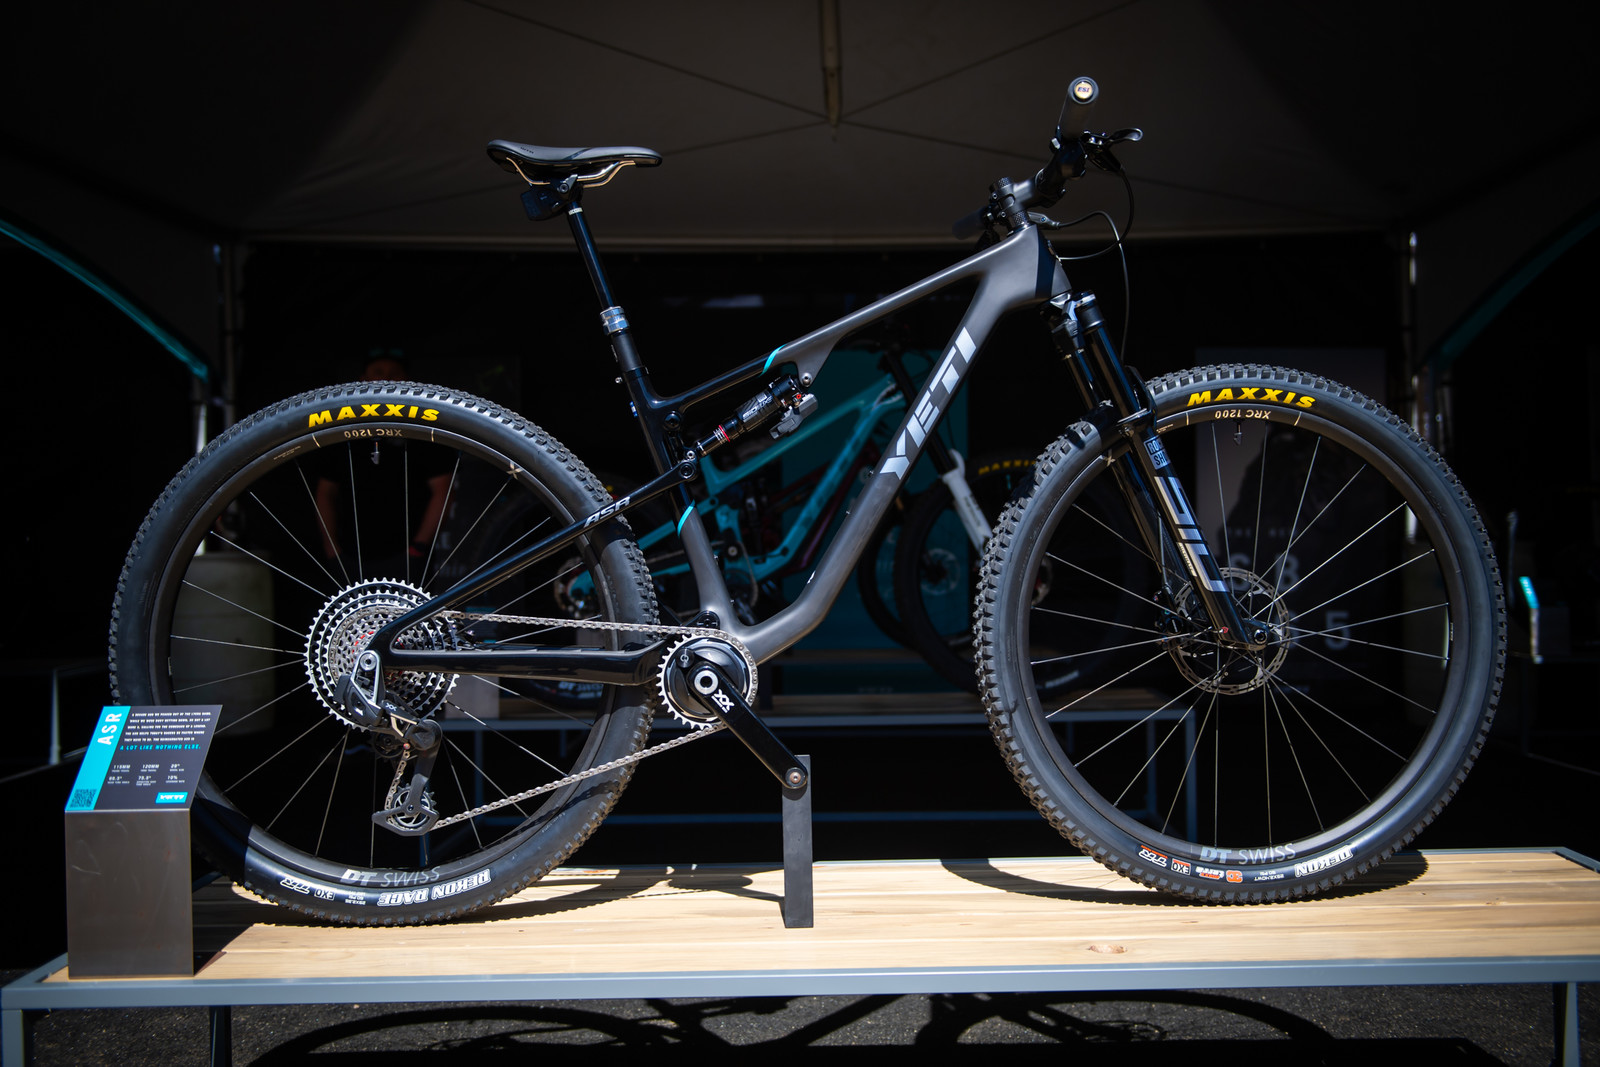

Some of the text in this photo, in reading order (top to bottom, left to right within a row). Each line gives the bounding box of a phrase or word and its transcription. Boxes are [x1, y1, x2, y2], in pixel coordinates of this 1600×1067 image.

[880, 327, 976, 480] YETI
[1187, 387, 1316, 408] MAXXIS
[308, 404, 439, 428] MAXXIS
[1214, 410, 1271, 420] XRC 1200
[344, 429, 372, 438] 1200
[584, 497, 630, 528] ASR
[386, 702, 397, 711] XX
[714, 690, 734, 710] XX
[98, 713, 122, 745] ASR
[1200, 844, 1296, 864] DT SWISS
[340, 866, 440, 888] DT SWISS
[1172, 862, 1190, 874] EXO
[316, 890, 334, 900] EXO
[377, 869, 492, 907] REKON RACE
